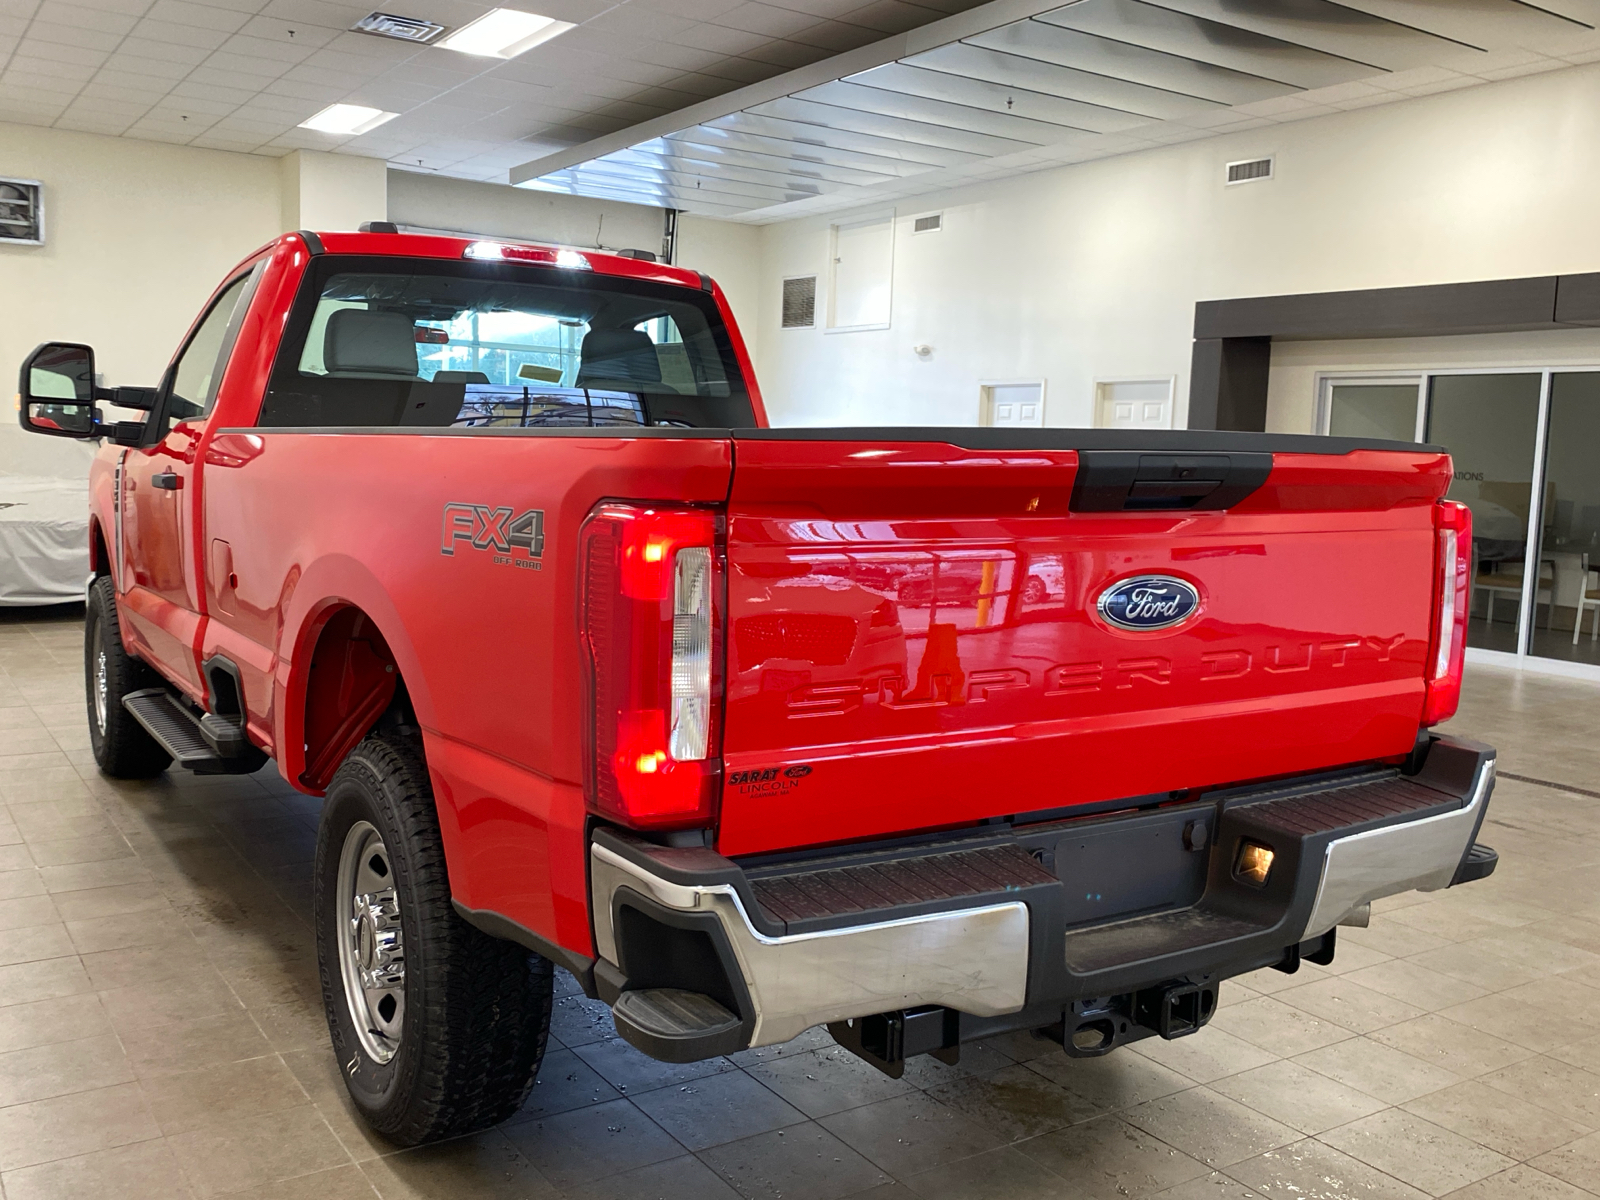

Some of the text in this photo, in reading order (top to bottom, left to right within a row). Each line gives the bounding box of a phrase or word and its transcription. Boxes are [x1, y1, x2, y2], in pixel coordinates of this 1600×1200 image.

[441, 502, 545, 559] FX4
[493, 556, 542, 571] OFF ROAD
[1125, 587, 1181, 619] Ford
[786, 633, 1406, 720] SUPER DUTY
[728, 767, 780, 786] SARAT
[740, 780, 799, 794] LINCOLN
